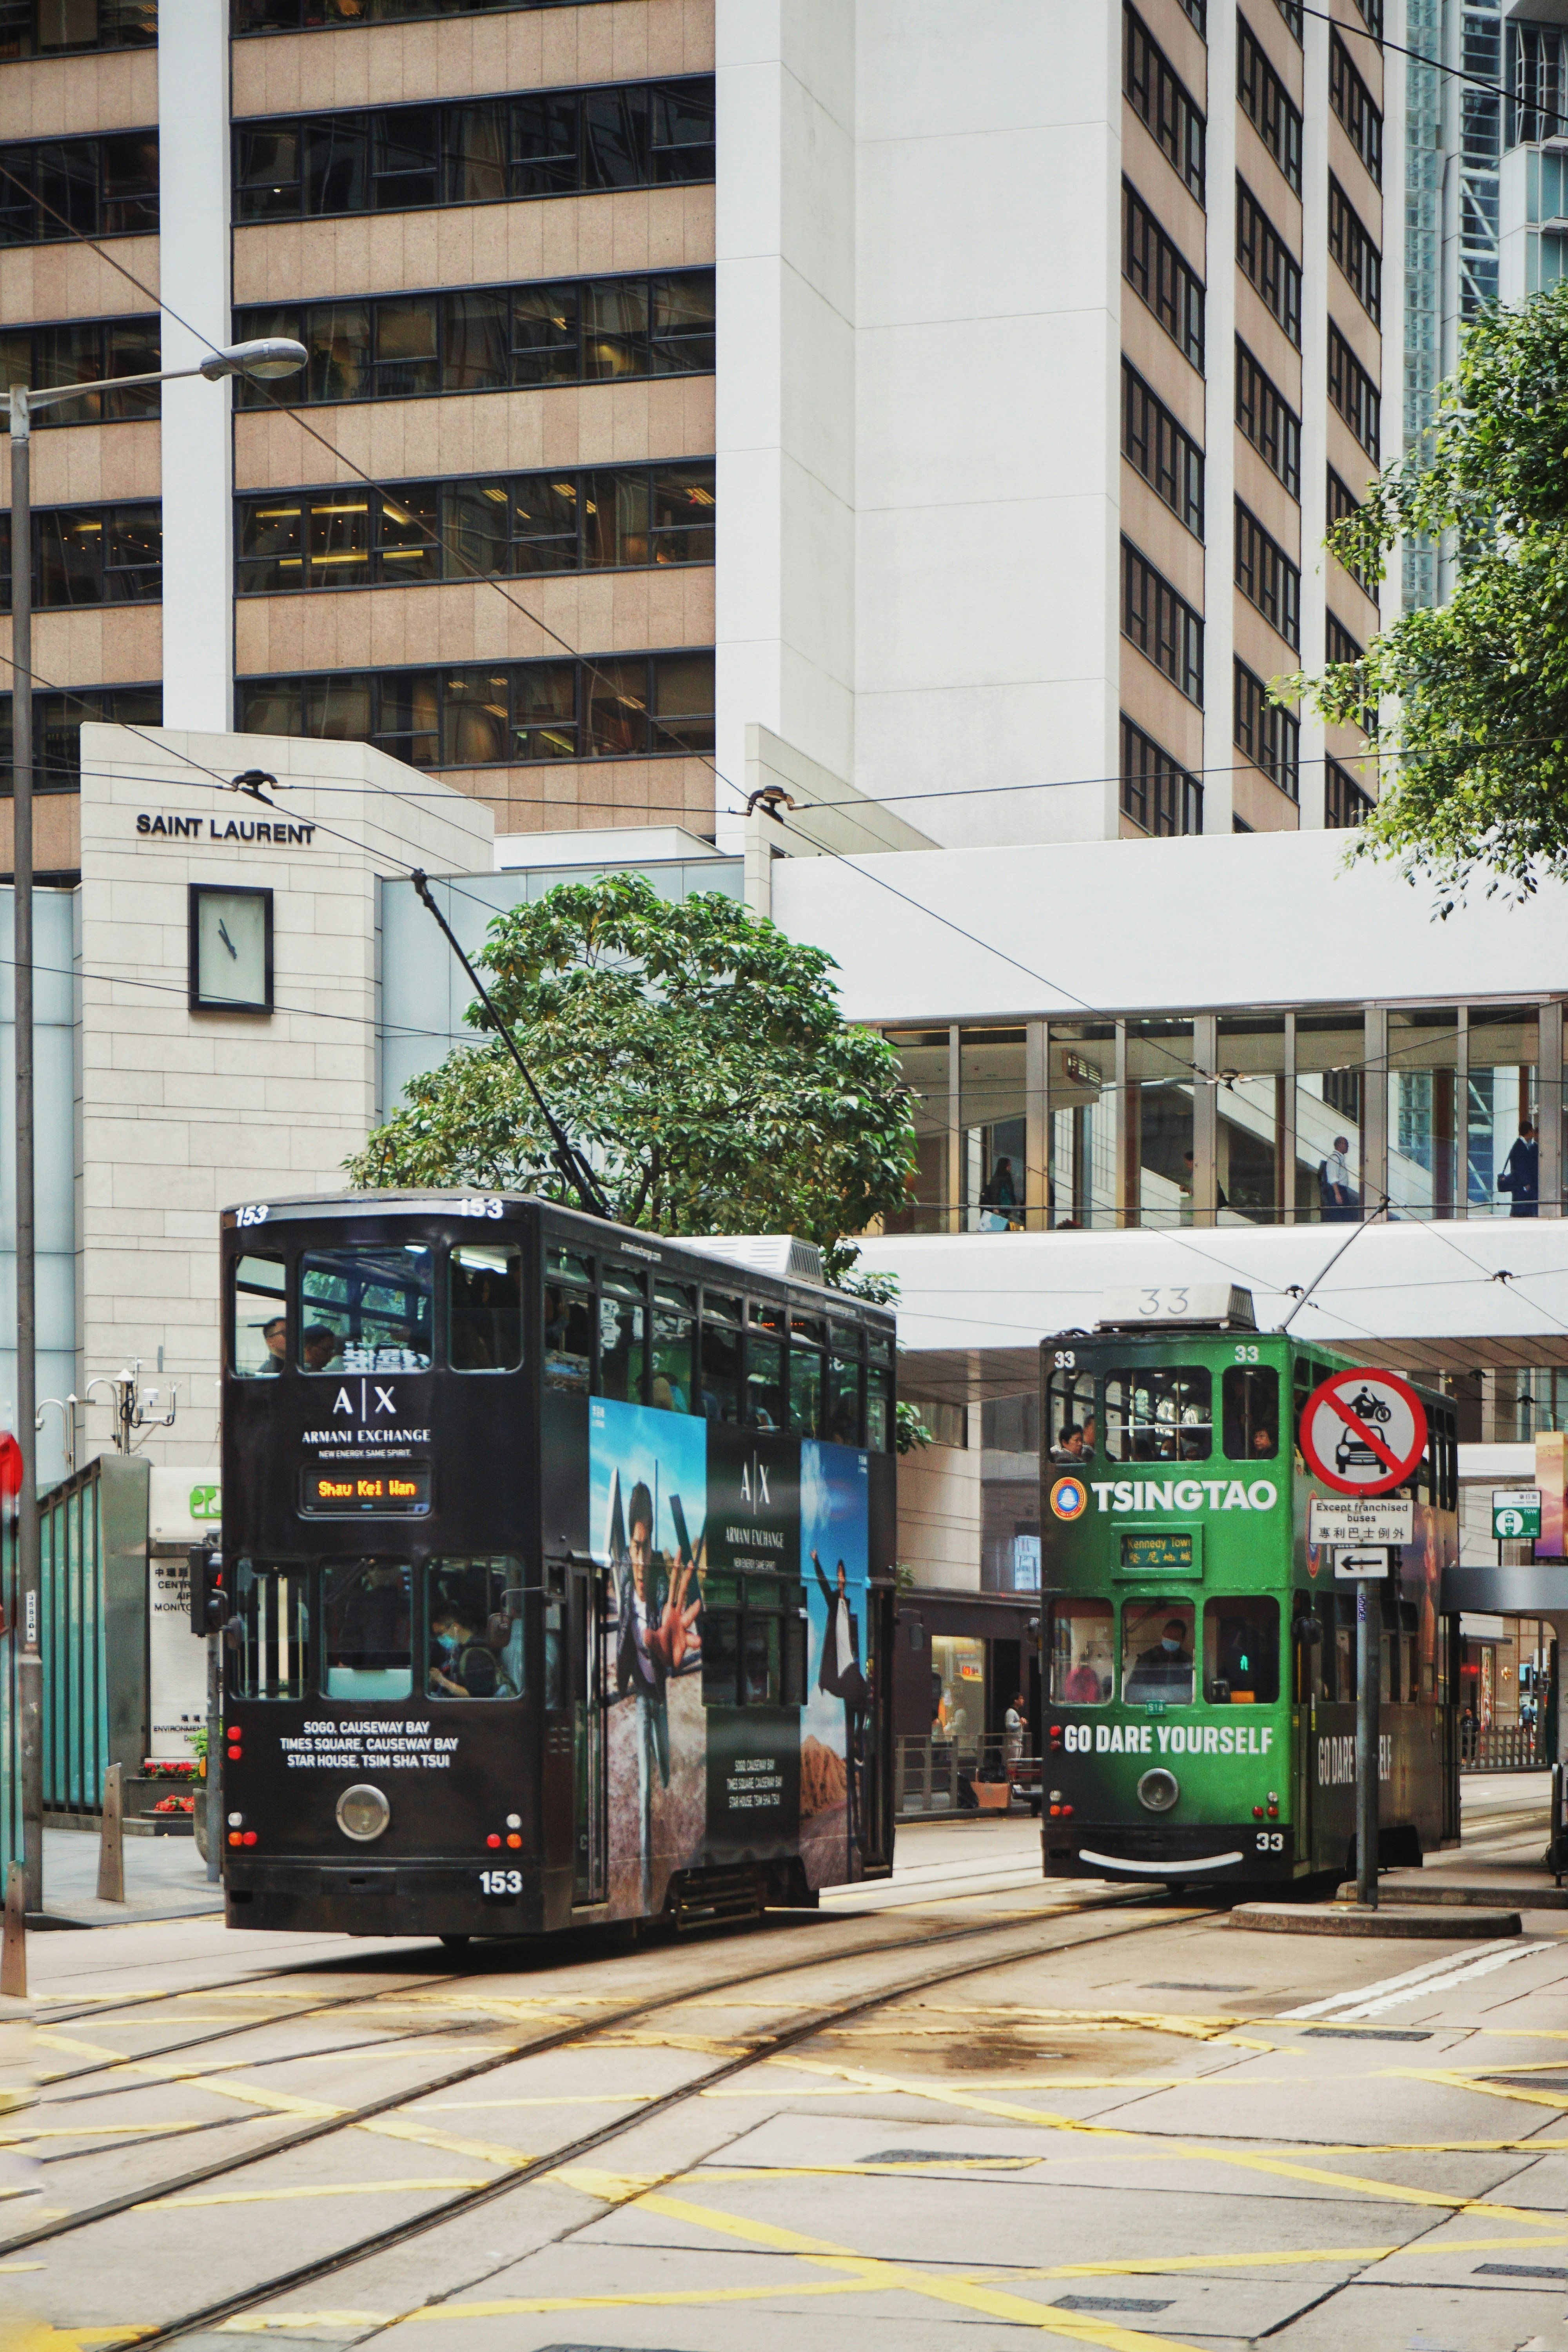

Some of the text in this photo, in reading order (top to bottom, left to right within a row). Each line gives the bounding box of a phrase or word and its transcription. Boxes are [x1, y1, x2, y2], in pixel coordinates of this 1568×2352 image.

[136, 813, 316, 844] SAINT LAURENT
[235, 1204, 269, 1227] 153
[457, 1198, 503, 1219] 153
[1138, 1287, 1189, 1315] 33
[1054, 1350, 1075, 1368] 33
[1234, 1345, 1259, 1362] 33
[302, 1429, 431, 1443] ARMANI EXCHANGE
[319, 1450, 335, 1459] NEW
[366, 1449, 386, 1458] SAME
[318, 1479, 416, 1497] Shau Kei Wan
[1090, 1479, 1278, 1512] TSINGTAO
[1316, 1503, 1408, 1512] Except franchised
[1347, 1514, 1376, 1522] buses
[726, 1526, 784, 1549] ARMANI EXCHANGE
[1318, 1527, 1405, 1539] 專利巴士例外
[1127, 1538, 1166, 1551] Kennedy
[339, 1721, 403, 1735] CAUSEWAY
[406, 1721, 430, 1734] BAY
[280, 1738, 312, 1751] TIMES
[366, 1738, 431, 1751] CAUSEWAY
[434, 1738, 459, 1751] BAY
[1065, 1725, 1273, 1754] GO DARE YOURSELF
[287, 1755, 315, 1768] STAR
[361, 1755, 390, 1768] TSIM
[392, 1755, 421, 1768] SHA
[421, 1755, 450, 1768] TSUI
[1318, 1737, 1330, 1786] GO
[1332, 1736, 1353, 1784] DARE
[1256, 1832, 1283, 1851] 33
[479, 1870, 523, 1895] 153
